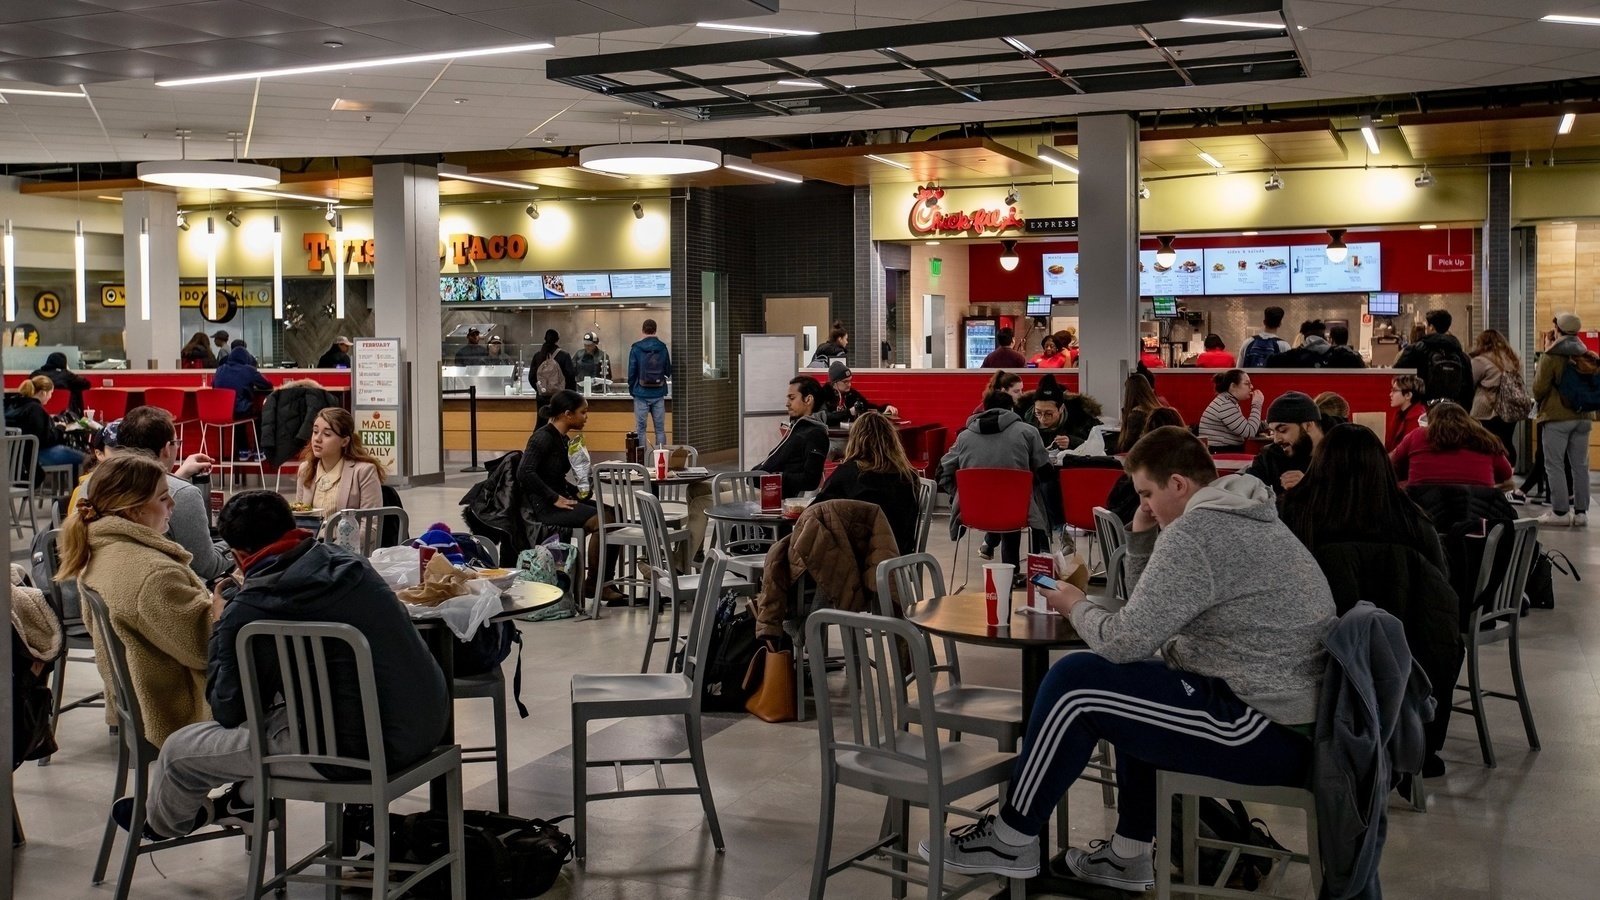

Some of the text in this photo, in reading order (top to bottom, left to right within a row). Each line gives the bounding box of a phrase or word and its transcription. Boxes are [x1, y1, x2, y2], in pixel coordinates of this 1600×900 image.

[1030, 220, 1077, 229] EXPRESS
[449, 233, 527, 265] TACO
[1438, 258, 1465, 267] Pick Up
[185, 291, 199, 301] DO
[362, 420, 391, 429] MADE
[362, 431, 391, 445] FRESH
